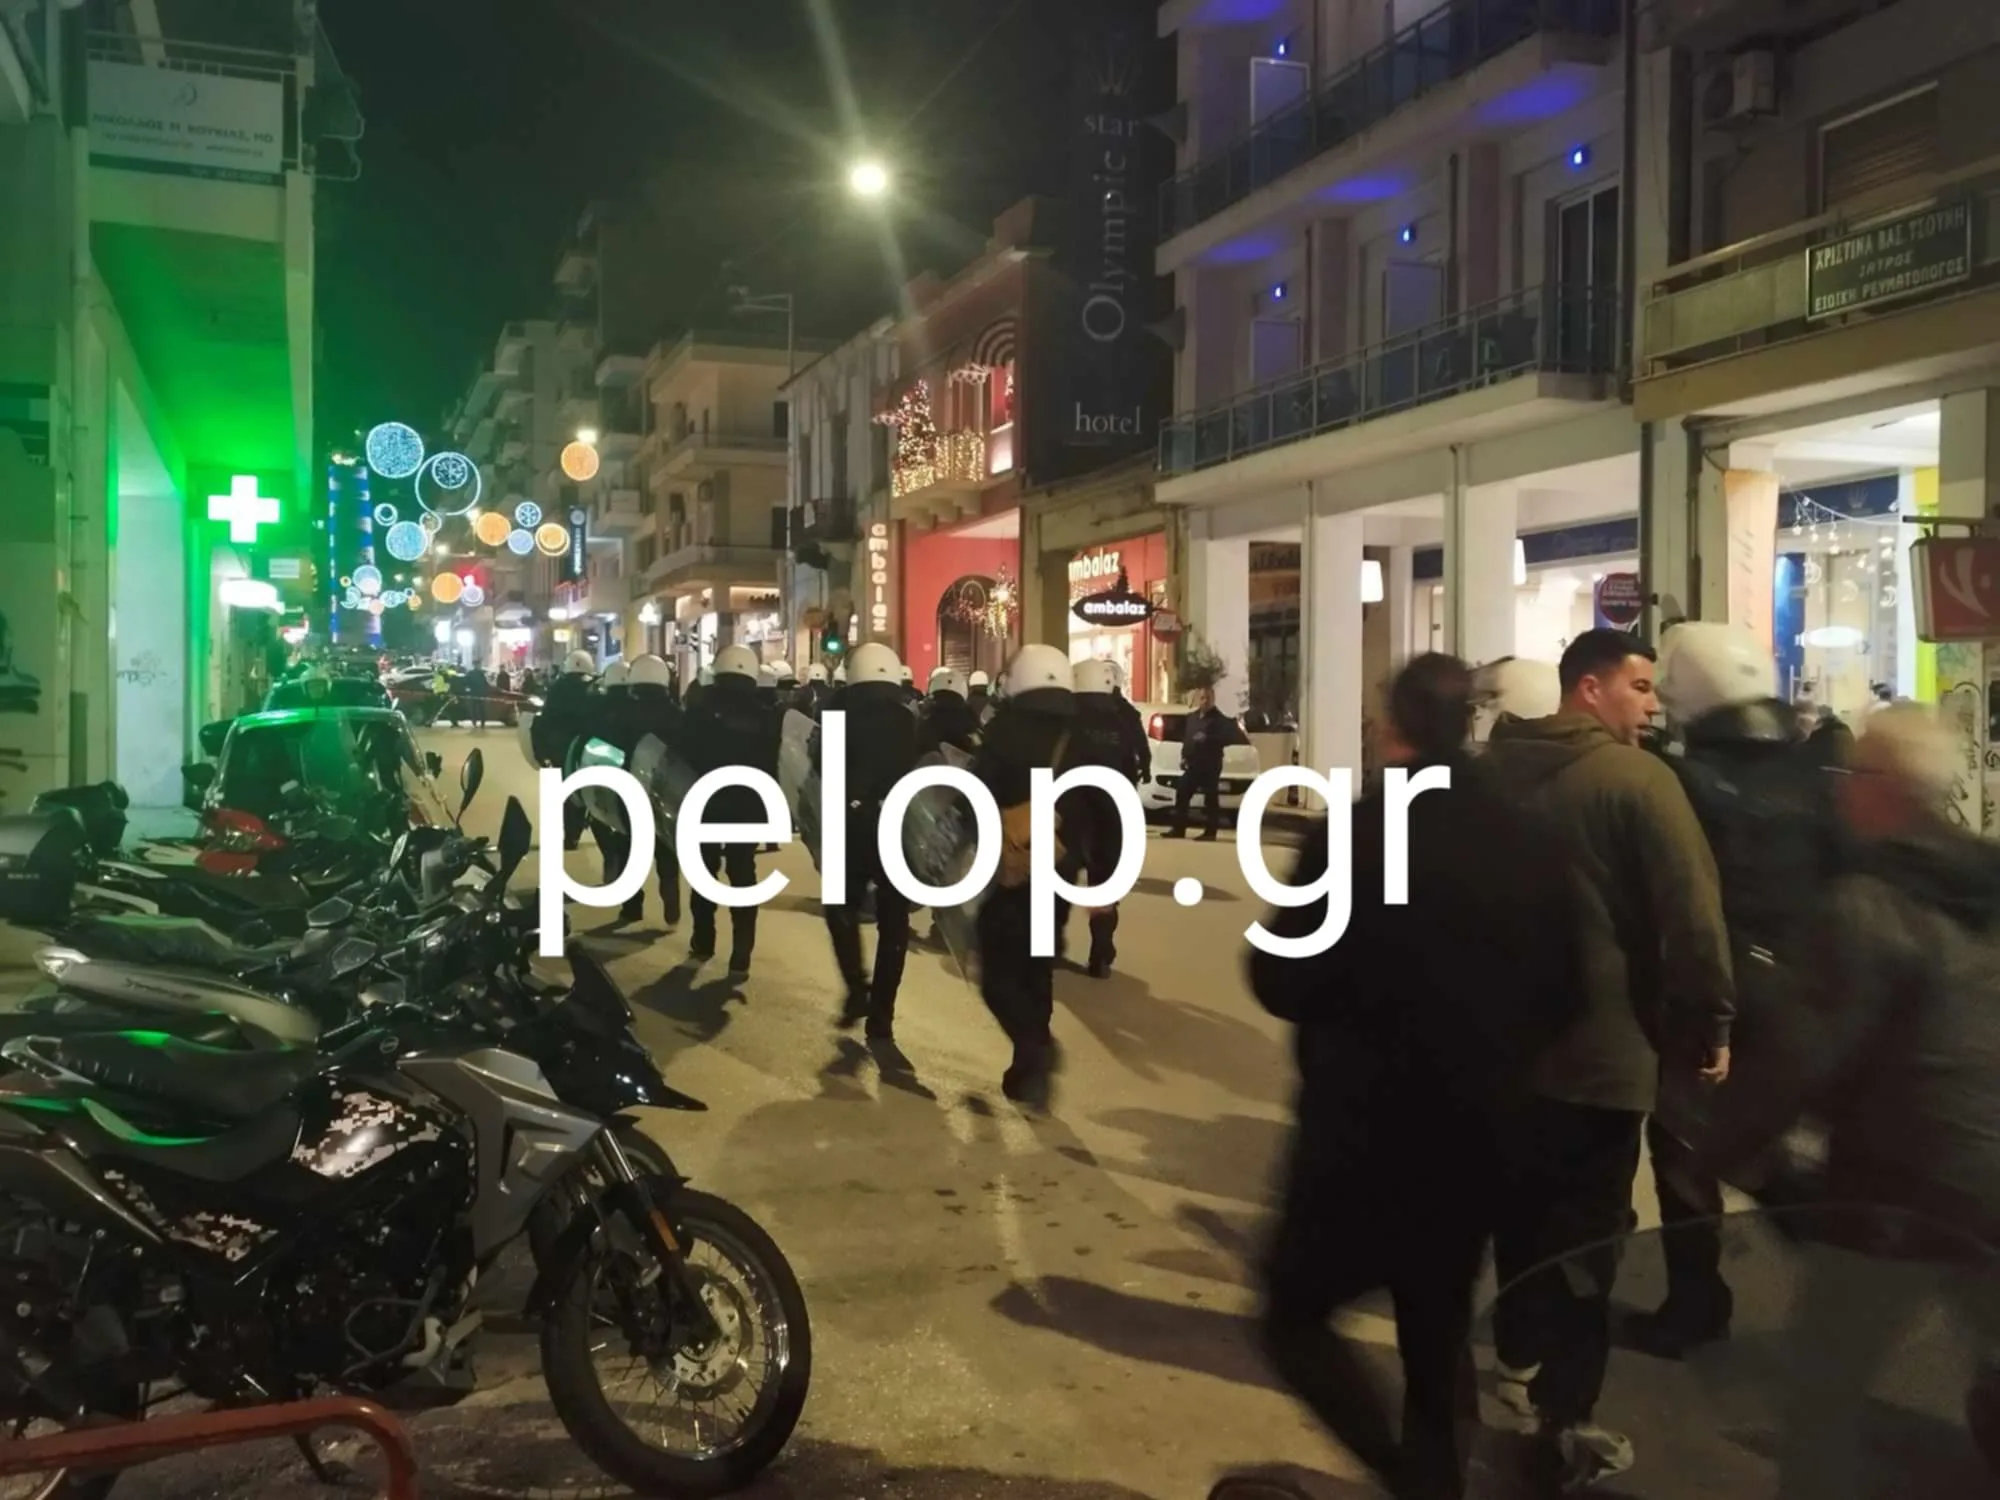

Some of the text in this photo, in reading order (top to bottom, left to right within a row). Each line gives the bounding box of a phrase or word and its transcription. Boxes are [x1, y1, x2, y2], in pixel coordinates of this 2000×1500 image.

[1085, 112, 1140, 137] star
[1082, 149, 1138, 342] Olympic
[1815, 233, 1873, 271] ΧΡΙΣΤΙΝΑ
[1075, 401, 1143, 435] hotel
[868, 523, 888, 632] ambalaz
[1083, 600, 1147, 615] ambalaz
